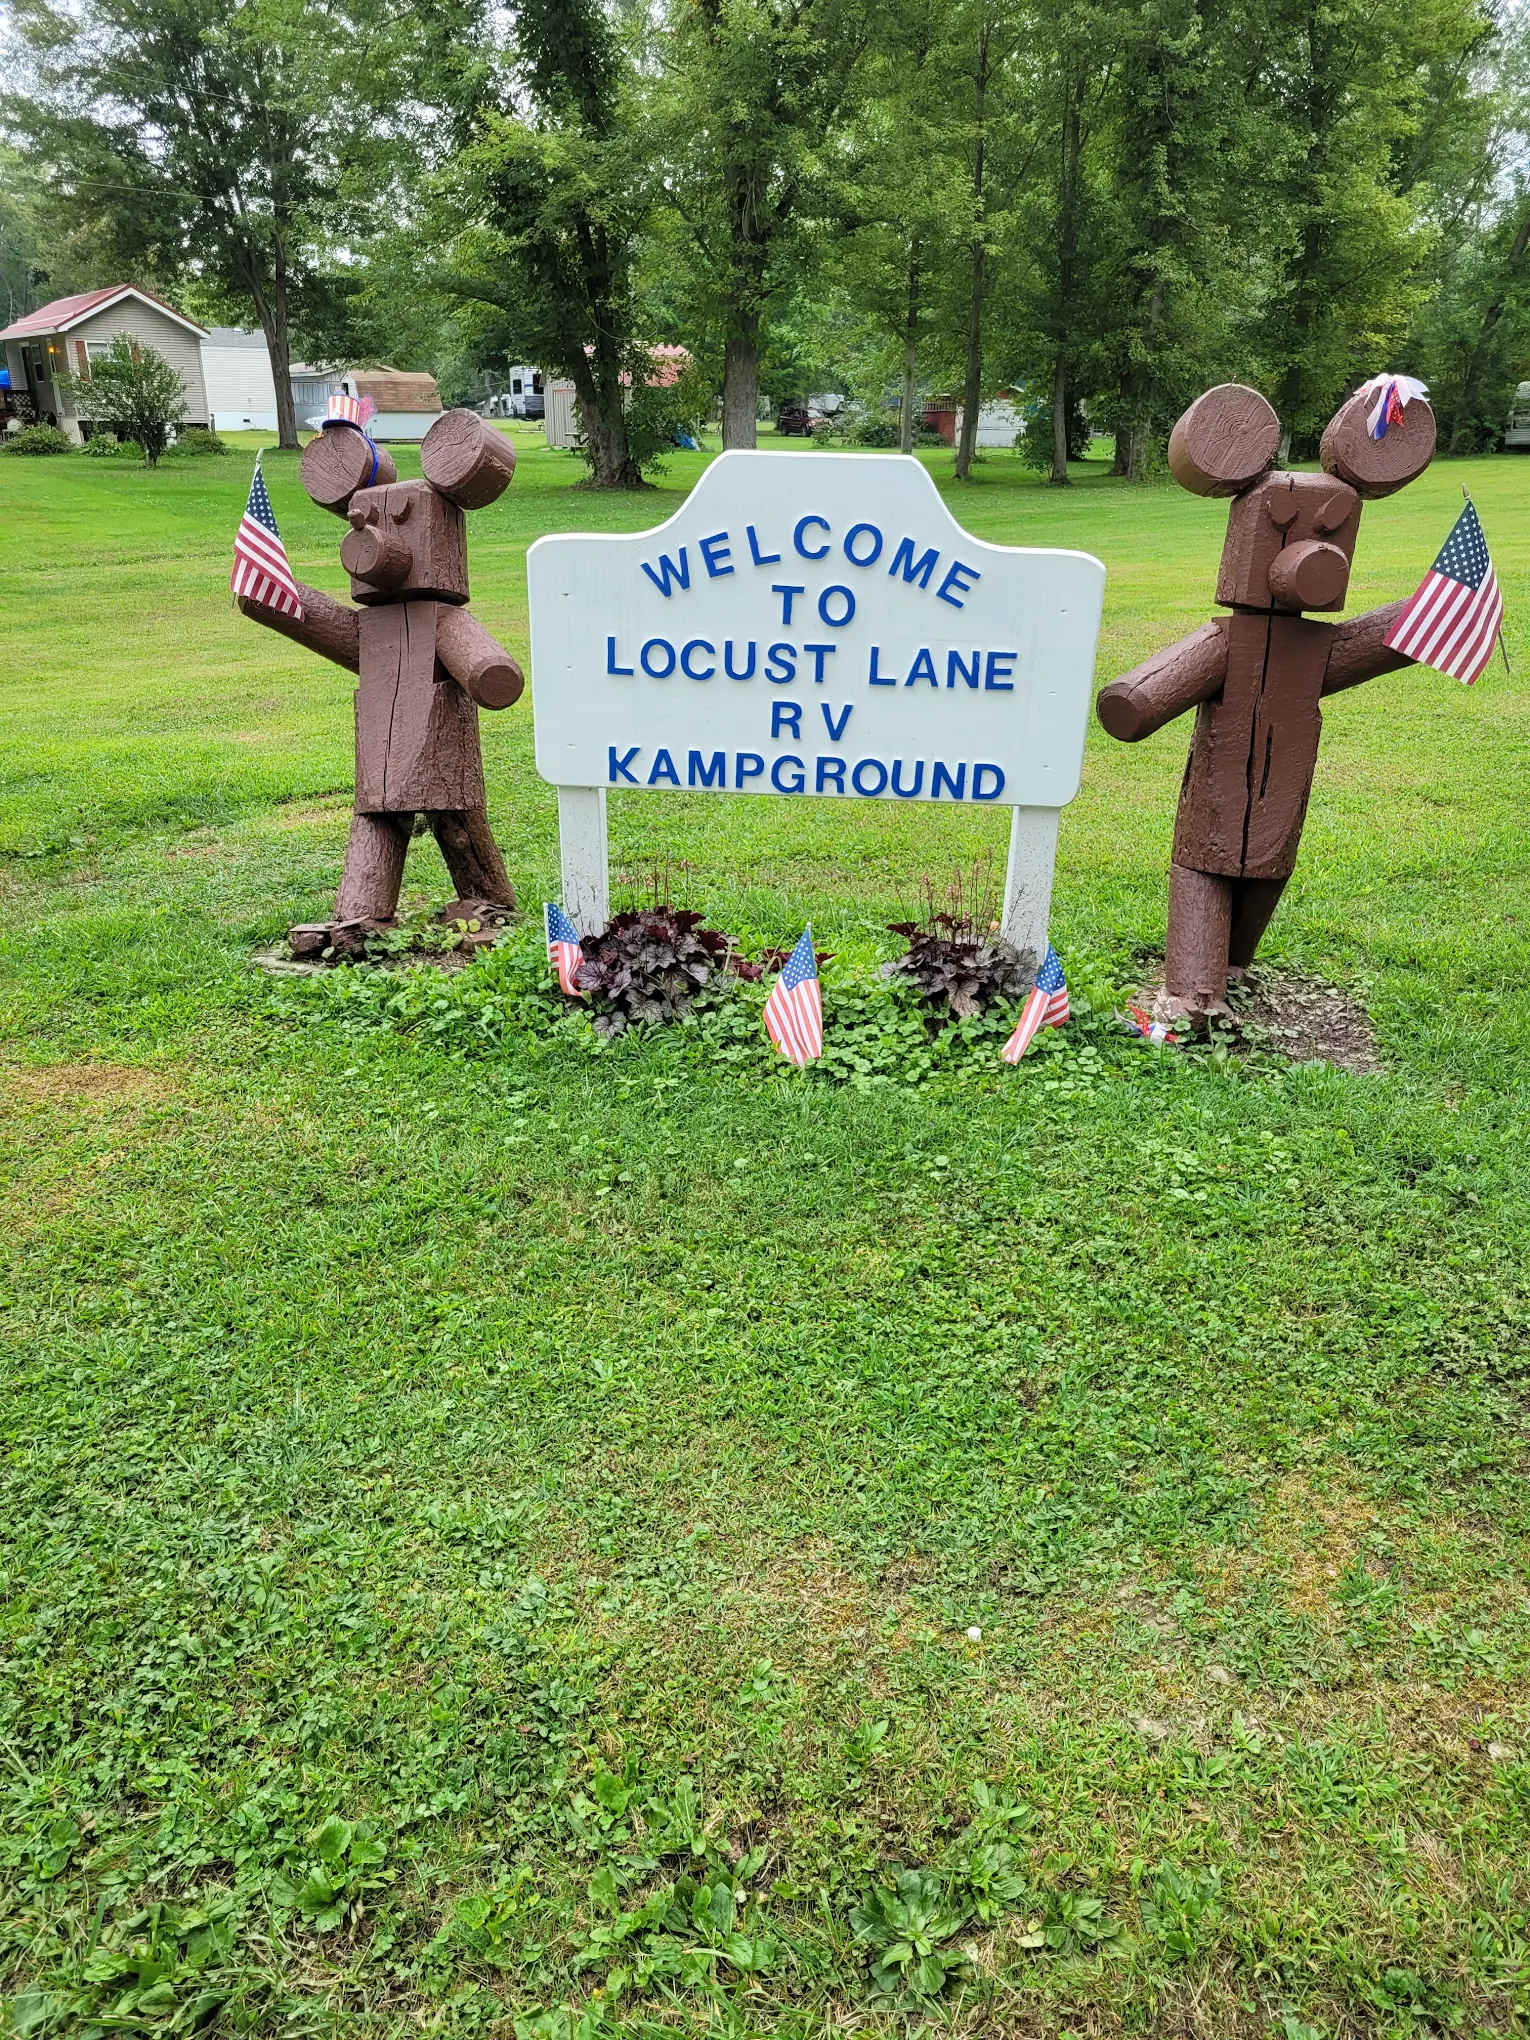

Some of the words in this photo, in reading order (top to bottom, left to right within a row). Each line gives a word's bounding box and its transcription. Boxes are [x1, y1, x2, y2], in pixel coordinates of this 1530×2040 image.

[640, 514, 982, 609] WELCOME
[770, 584, 857, 628] TO
[606, 635, 838, 686] LOCUST
[868, 645, 1019, 692] LANE
[770, 700, 854, 742] RV
[607, 745, 1006, 801] KAMPGROUND
